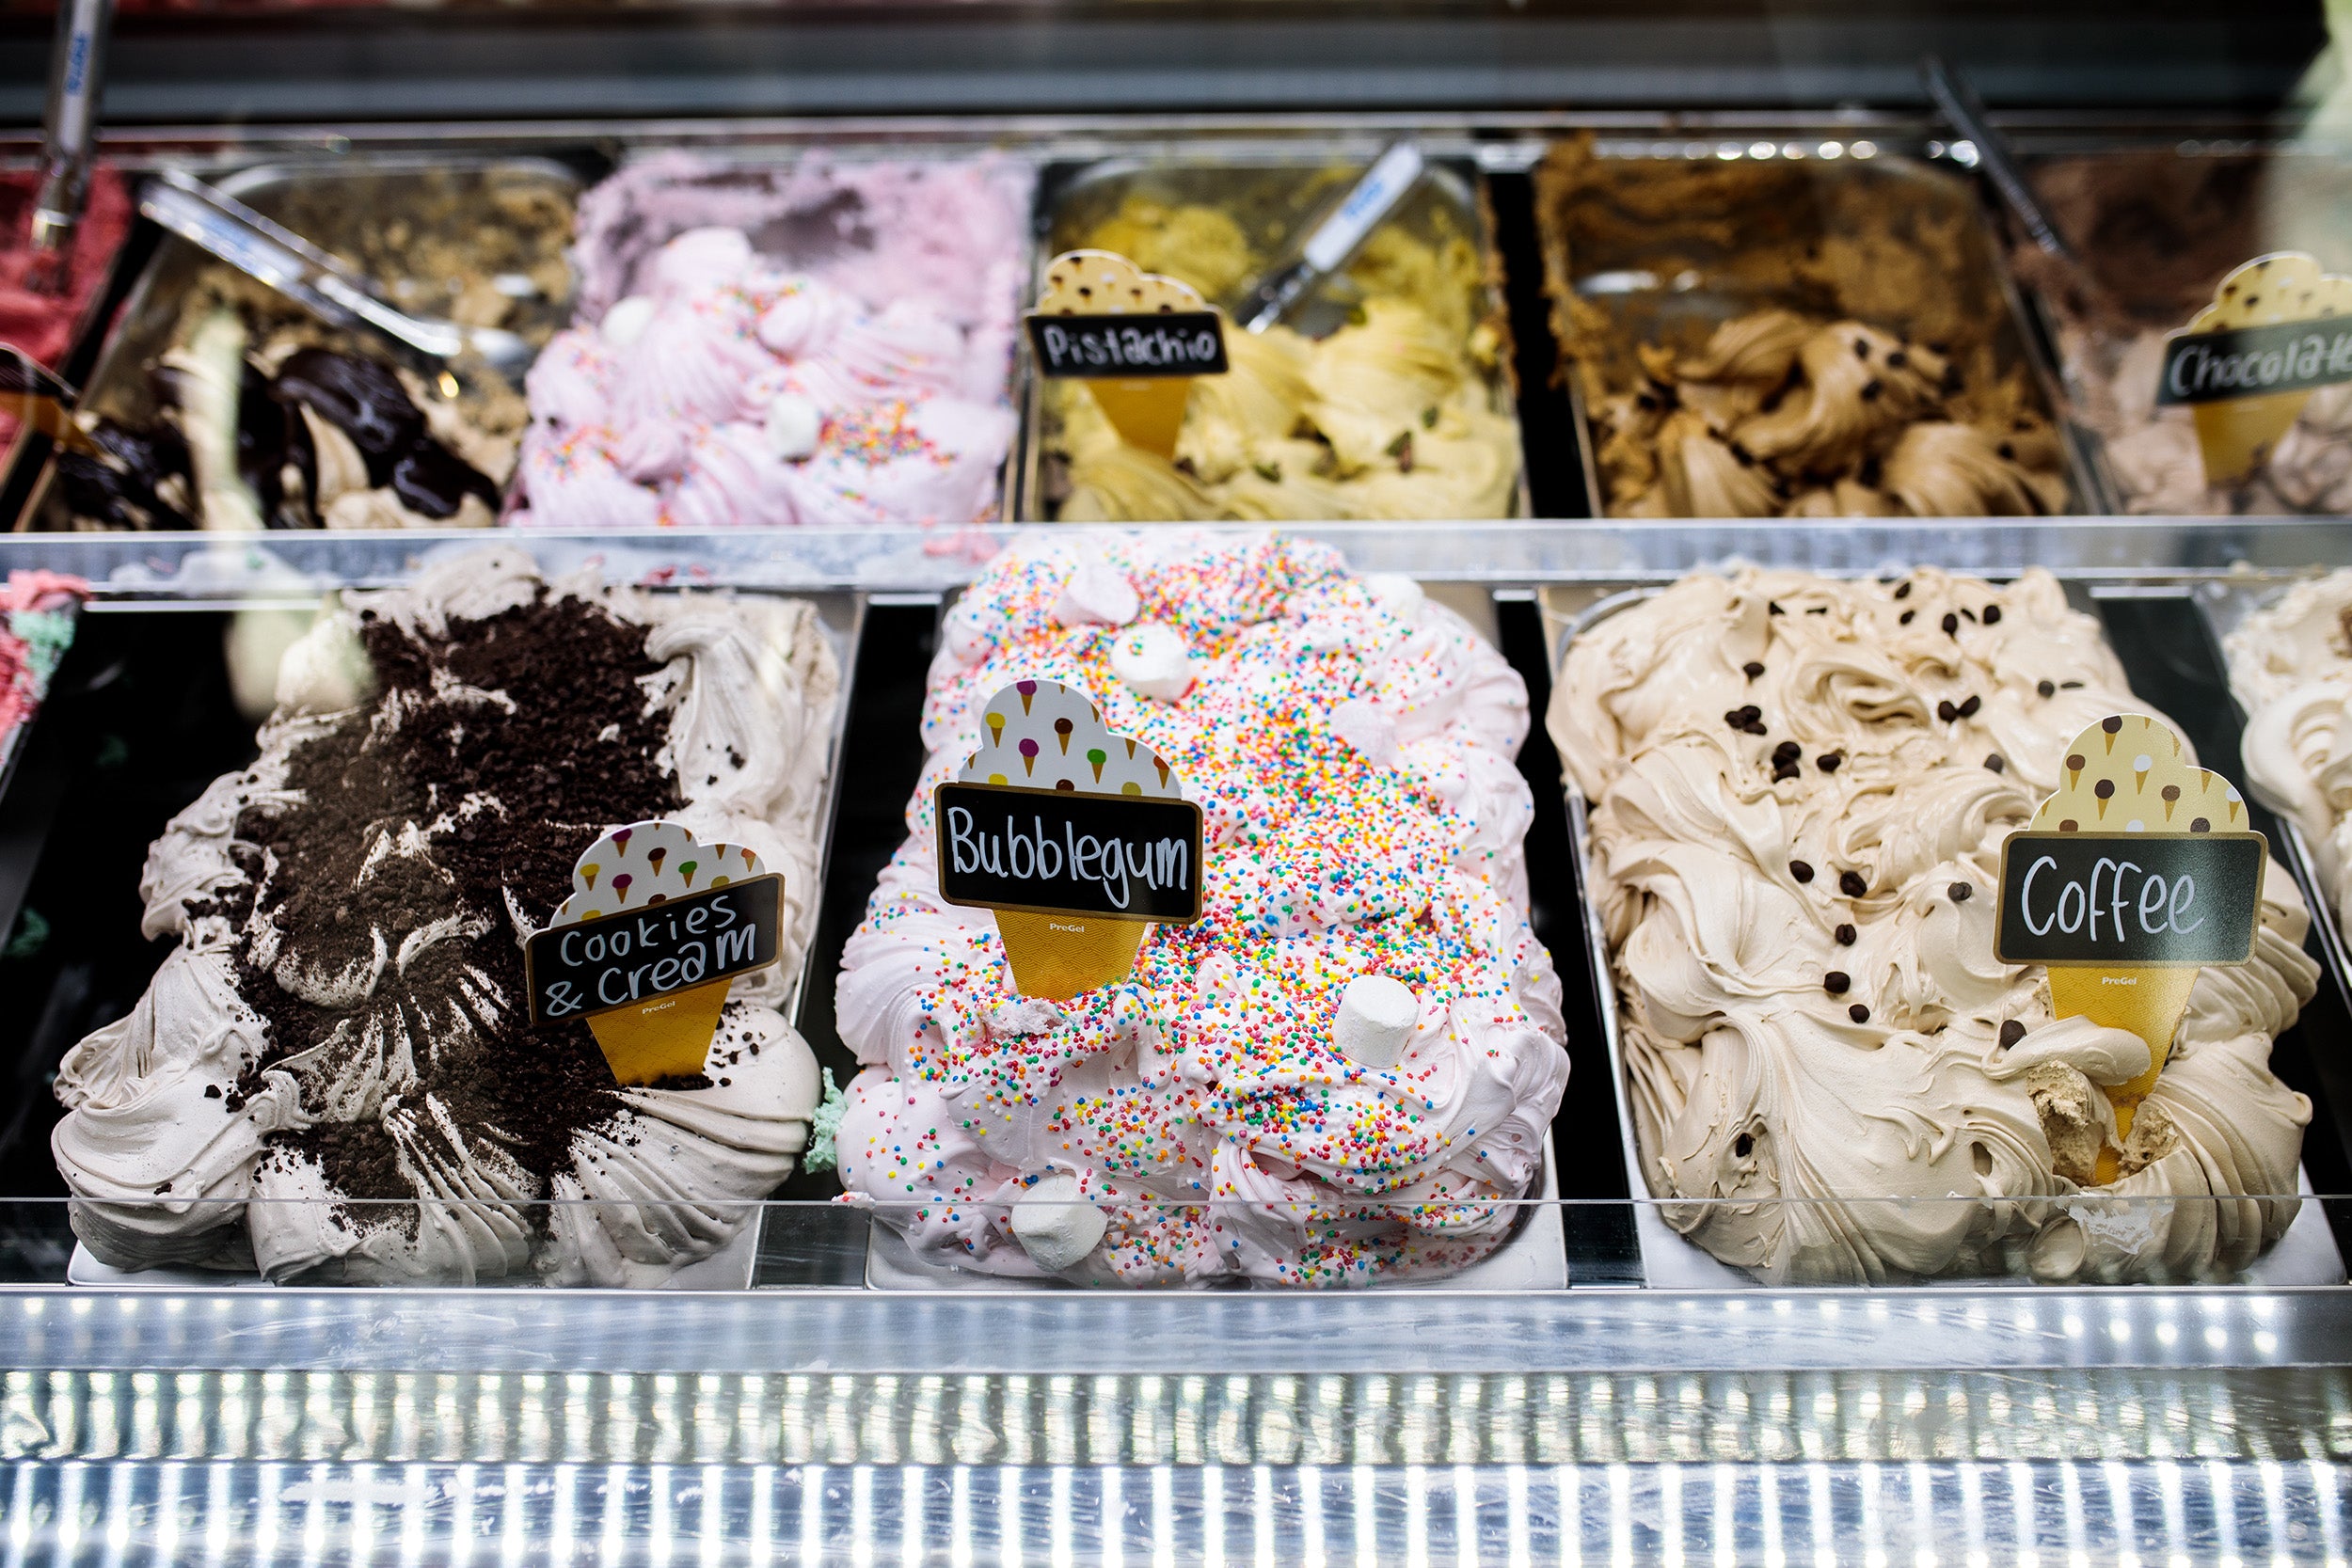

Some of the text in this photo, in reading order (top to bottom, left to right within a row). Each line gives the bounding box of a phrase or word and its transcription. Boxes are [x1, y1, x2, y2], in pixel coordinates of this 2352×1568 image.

[1042, 324, 1216, 368] Pistachio
[948, 806, 1187, 910] Bubblegum
[2022, 855, 2205, 942] Coffee
[560, 895, 737, 966] Cookies
[1049, 923, 1085, 933] PreGel
[546, 980, 583, 1017] &
[2101, 976, 2137, 986] PreGel
[642, 1000, 675, 1015] PreGel
